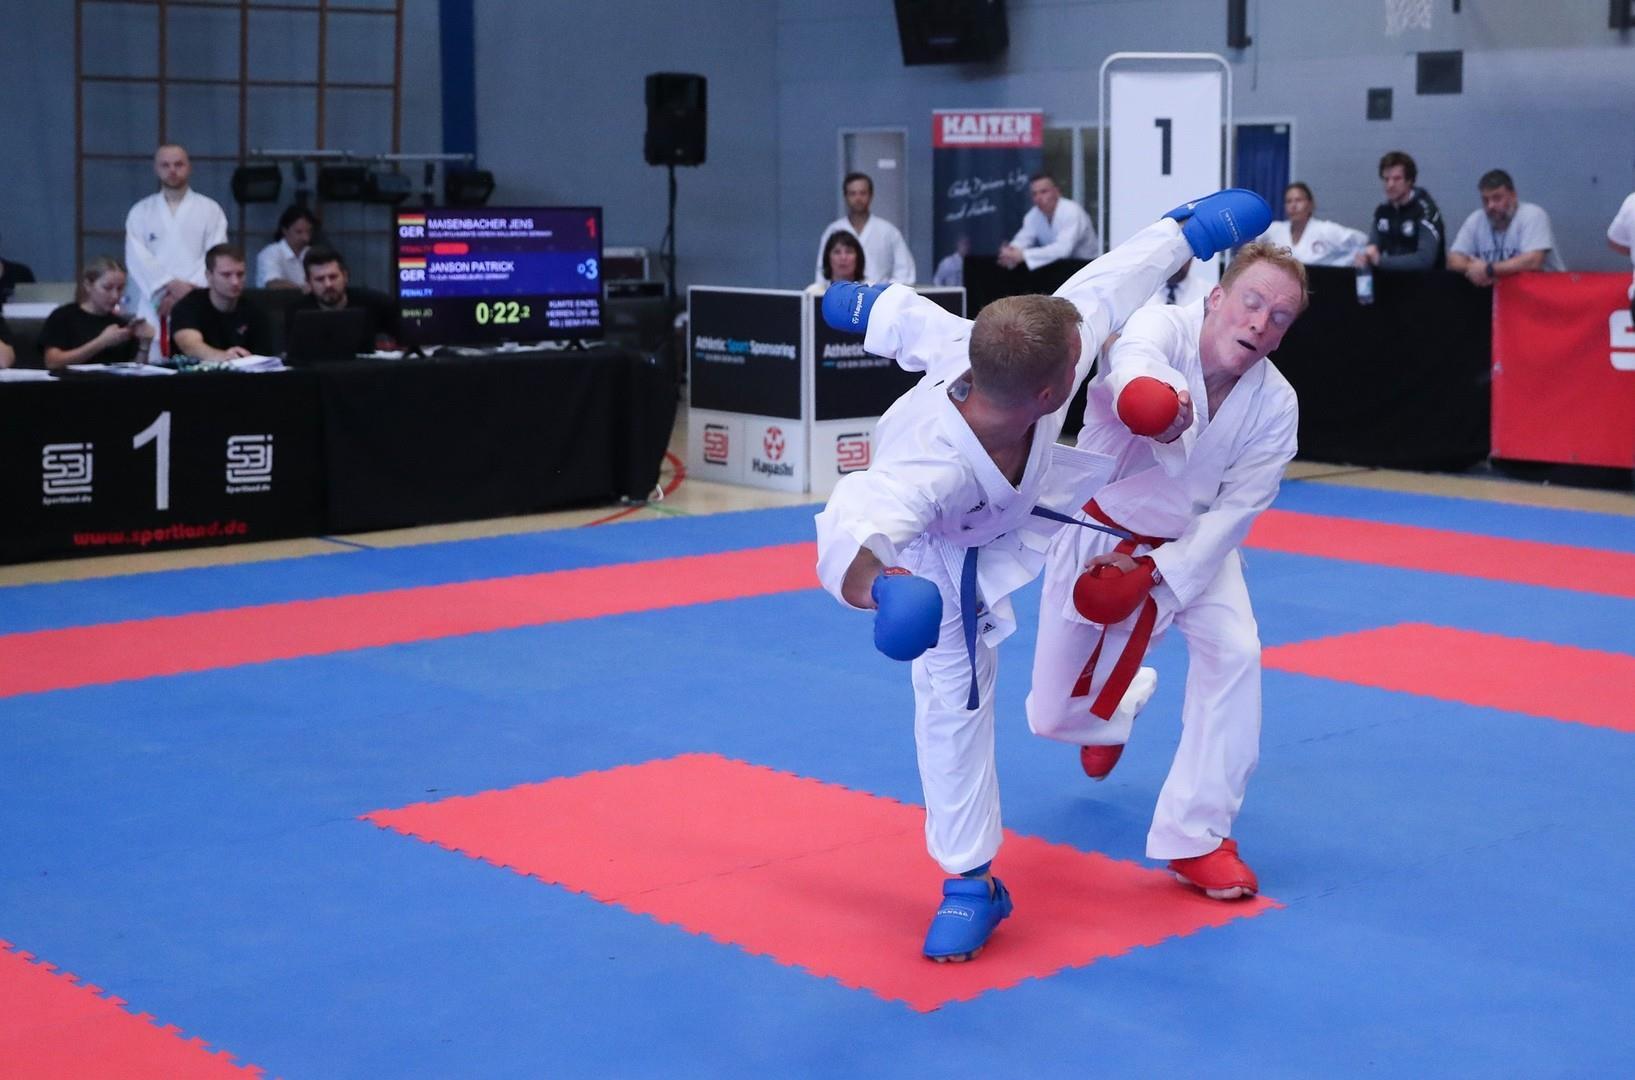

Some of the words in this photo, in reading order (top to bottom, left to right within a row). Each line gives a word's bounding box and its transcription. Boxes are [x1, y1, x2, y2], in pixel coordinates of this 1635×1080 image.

[943, 115, 1032, 134] KAITEN
[1154, 117, 1173, 177] 1
[399, 225, 425, 239] GER
[428, 218, 508, 230] MAISENBACHER
[509, 218, 534, 230] JENS
[586, 217, 597, 238] 1
[400, 269, 426, 282] GER
[428, 262, 470, 273] JANSON
[471, 261, 515, 273] PATRICK
[400, 288, 433, 298] PENALTY
[132, 410, 172, 511] 1
[751, 458, 795, 480] Hayashi
[73, 520, 248, 546] www.sportland.de
